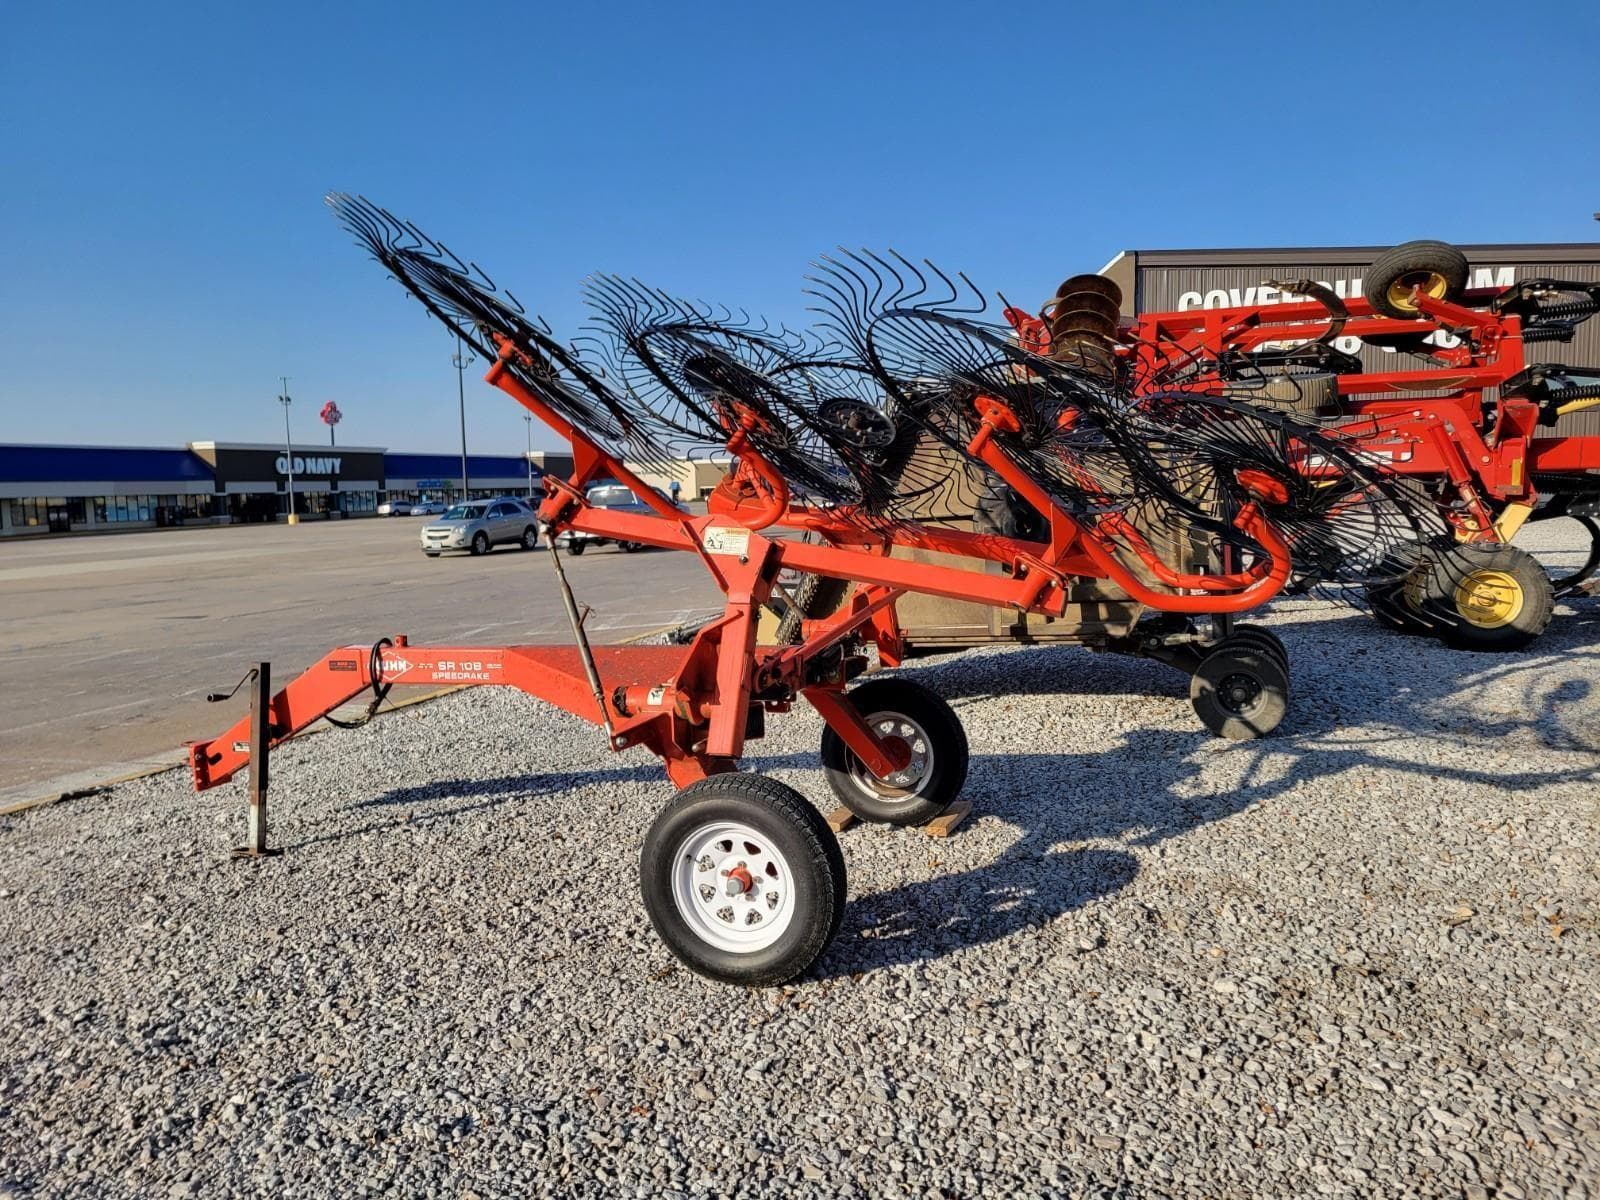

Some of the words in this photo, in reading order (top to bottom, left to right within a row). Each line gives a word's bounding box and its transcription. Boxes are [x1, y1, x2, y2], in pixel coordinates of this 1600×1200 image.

[275, 456, 305, 475] OD
[305, 457, 342, 475] NAVY
[437, 661, 456, 671] SR
[431, 671, 490, 680] SPEEDRAKE
